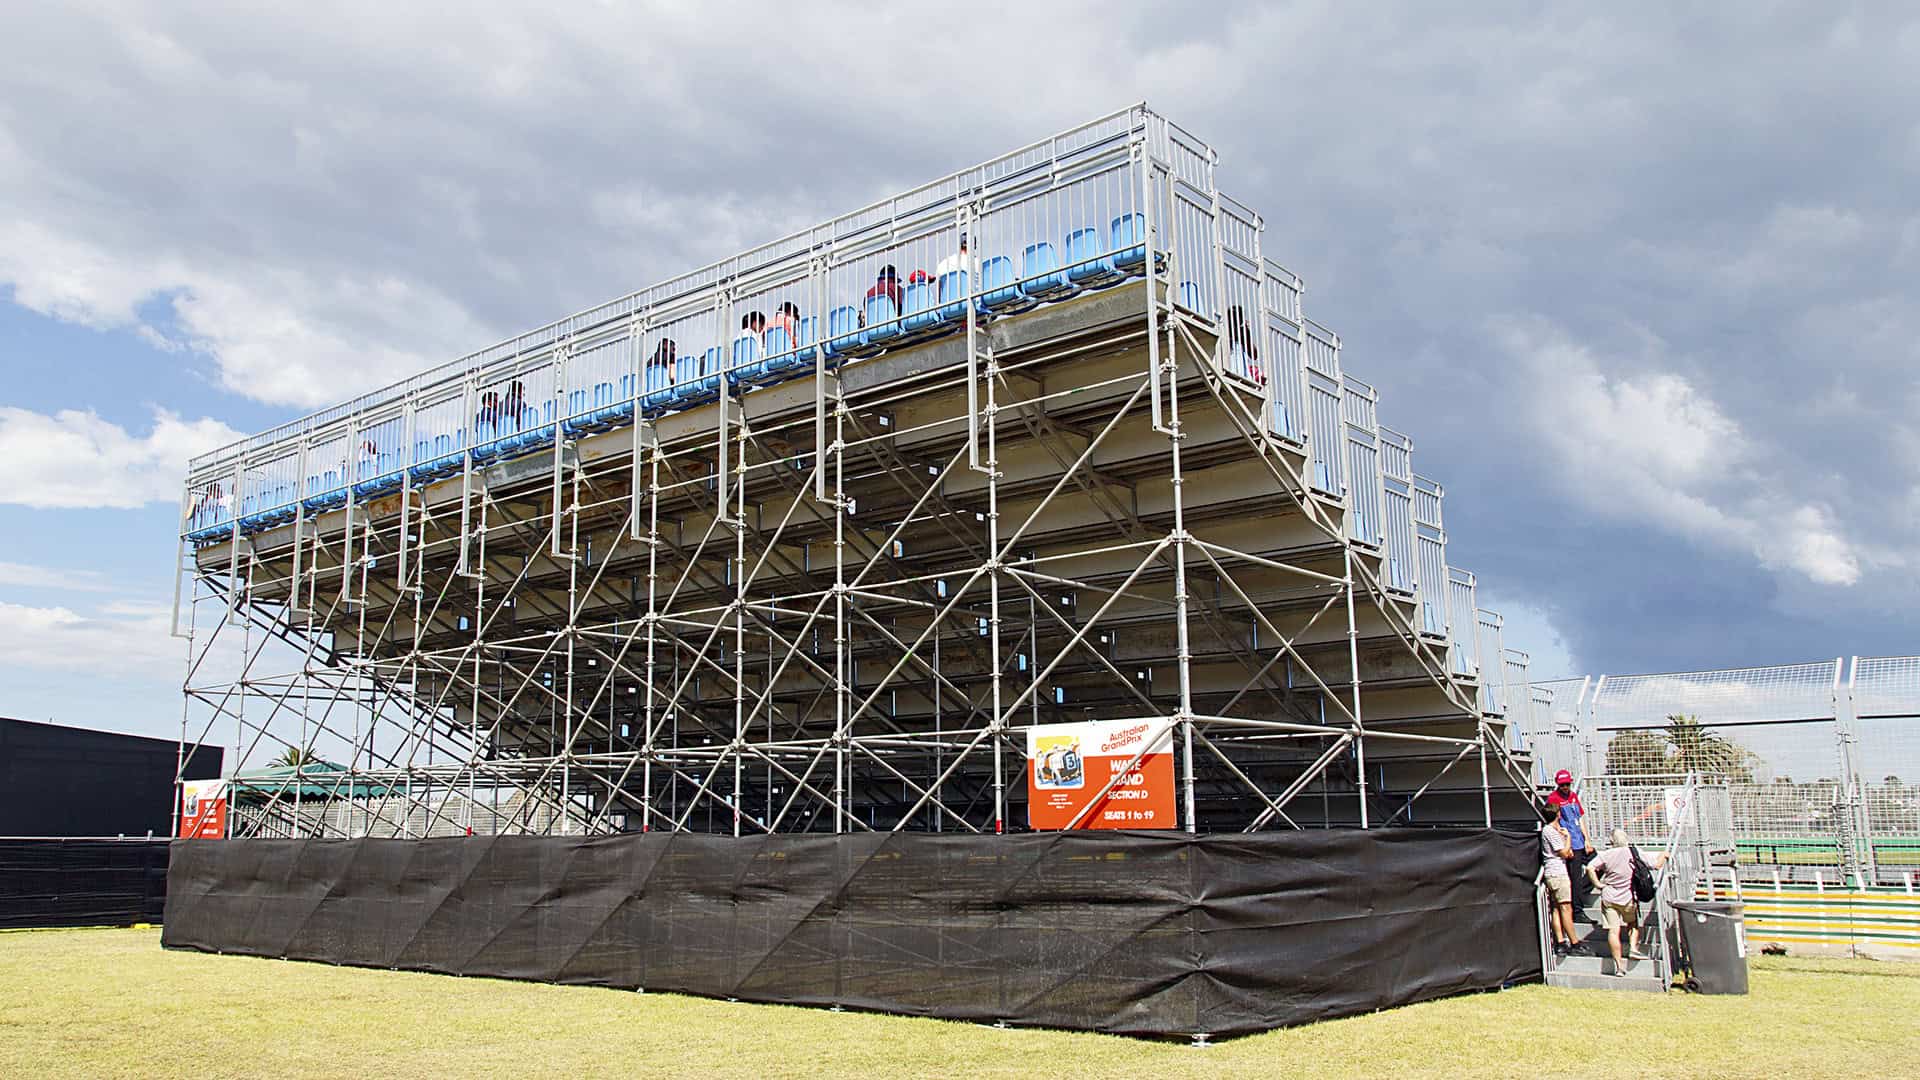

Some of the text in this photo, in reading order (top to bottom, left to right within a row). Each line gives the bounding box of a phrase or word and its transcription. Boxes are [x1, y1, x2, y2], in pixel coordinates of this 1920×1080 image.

[1110, 724, 1149, 741] Australian
[1067, 755, 1075, 768] 3
[1107, 790, 1148, 800] SECTION D
[1127, 811, 1132, 820] 1
[1133, 811, 1143, 820] to
